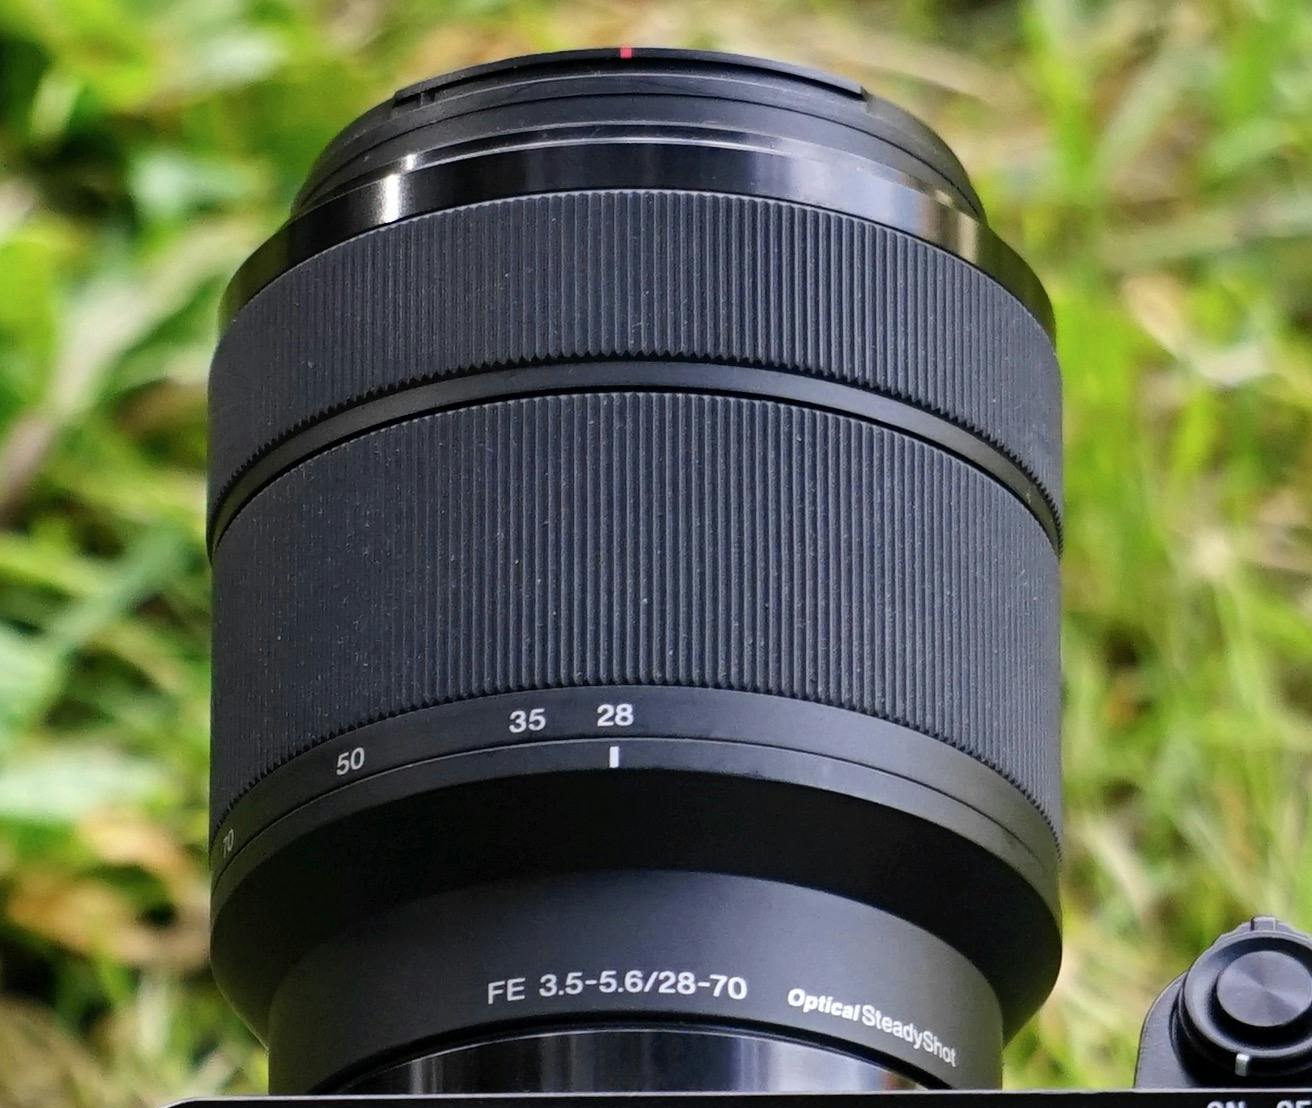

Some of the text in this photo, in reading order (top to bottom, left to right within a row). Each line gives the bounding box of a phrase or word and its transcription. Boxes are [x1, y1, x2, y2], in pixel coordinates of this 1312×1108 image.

[335, 746, 365, 777] 50
[508, 709, 546, 733] 35
[596, 703, 634, 728] 28
[488, 970, 749, 1003] FE 3.5-5.6/28-70
